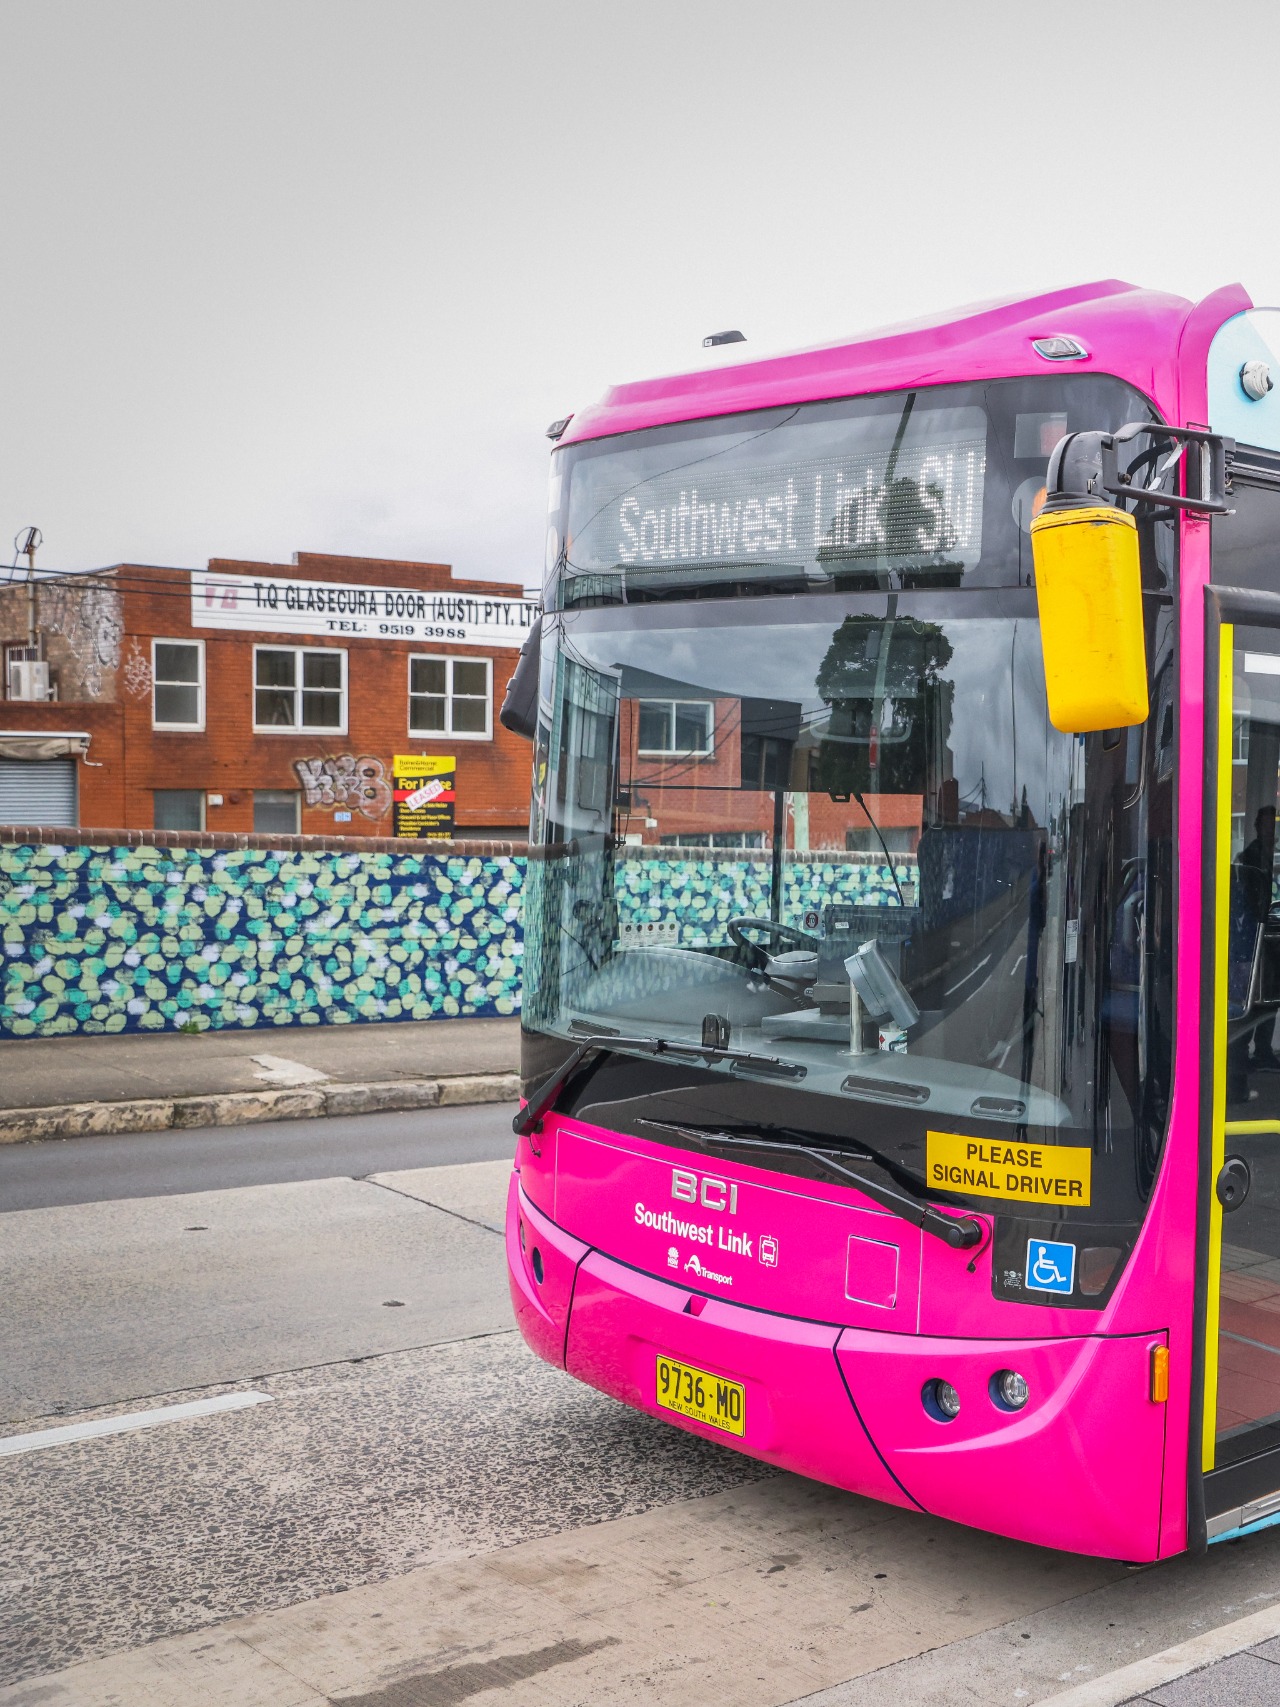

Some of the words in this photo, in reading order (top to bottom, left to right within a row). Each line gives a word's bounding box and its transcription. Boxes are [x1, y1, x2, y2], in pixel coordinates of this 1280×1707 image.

[619, 478, 798, 562] Southwest
[814, 469, 886, 546] Link
[918, 451, 986, 549] SW
[386, 593, 425, 618] DOOR
[432, 597, 478, 625] (AUST)
[485, 601, 514, 626] PTY.
[326, 620, 367, 632] TEL:
[379, 624, 414, 635] 9519
[425, 627, 466, 639] 3988
[399, 778, 418, 790] For
[408, 783, 441, 807] LEASED
[967, 1143, 1042, 1168] PLEASE
[671, 1168, 738, 1215] BCI
[933, 1163, 1000, 1190] SIGNAL
[1006, 1174, 1083, 1198] DRIVER
[634, 1202, 713, 1246] Southwest
[718, 1226, 753, 1258] Link
[667, 1257, 678, 1266] NSW
[701, 1267, 733, 1286] Transport
[668, 1399, 683, 1410] NEW
[685, 1405, 706, 1421] SOUTH
[709, 1415, 730, 1430] WALES
